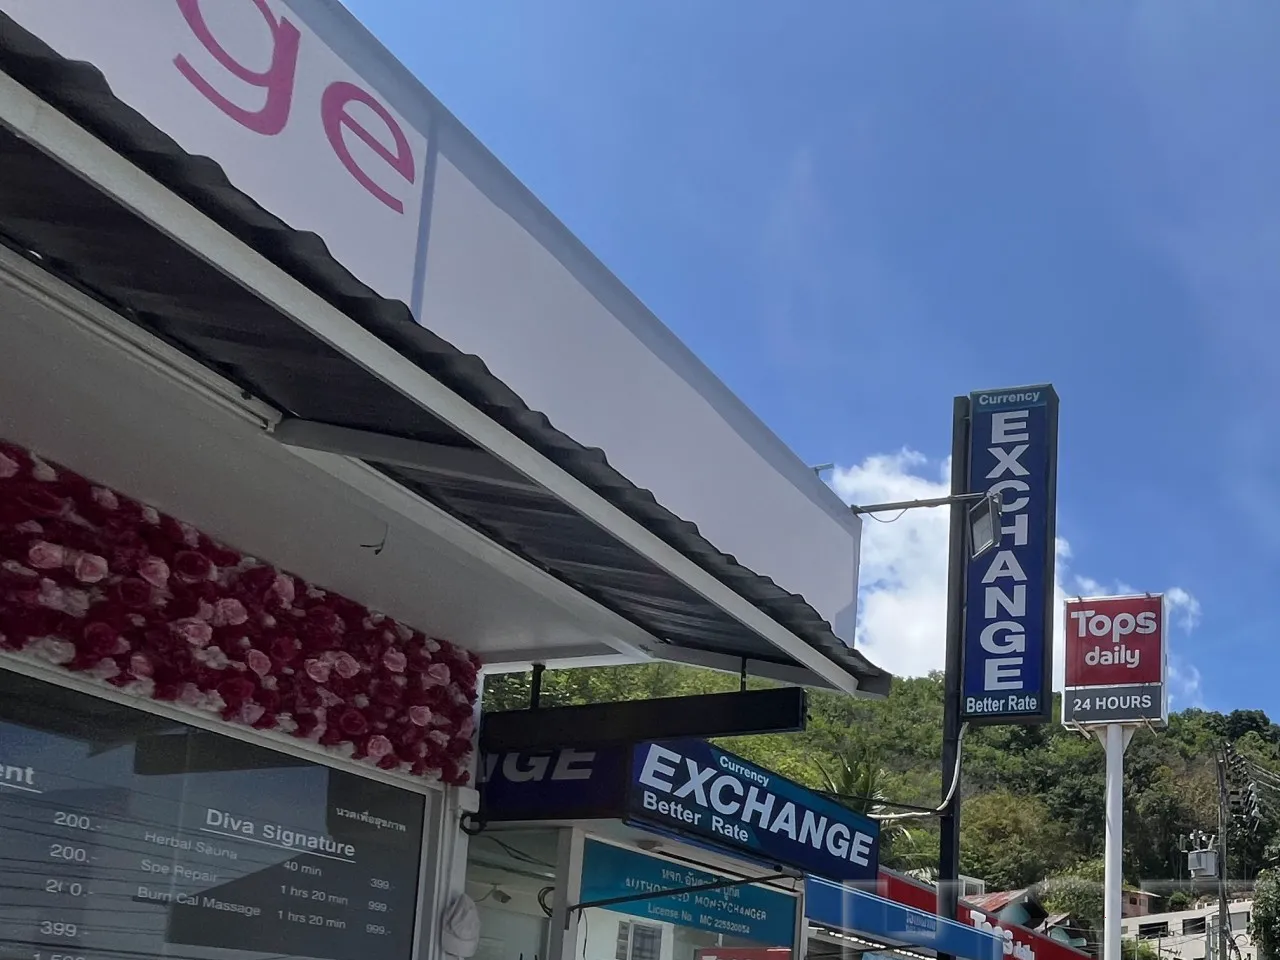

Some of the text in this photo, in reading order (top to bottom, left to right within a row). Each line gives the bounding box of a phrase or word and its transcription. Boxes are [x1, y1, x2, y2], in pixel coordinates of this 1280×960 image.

[979, 391, 1040, 406] Currency
[979, 410, 1030, 691] EXCHANGE
[1070, 610, 1157, 643] Tops
[1084, 645, 1140, 669] daily
[966, 696, 1038, 713] Better Rate
[1073, 694, 1152, 712] 24 HOURS
[719, 754, 770, 787] Currency
[638, 742, 875, 868] EXCHANGE
[643, 790, 749, 843] Better Rate
[144, 831, 192, 850] Herbal
[206, 808, 356, 858] Diva Signature
[283, 861, 322, 876] 40 min
[137, 886, 262, 917] Burn Cal Massage
[290, 886, 309, 899] hrs
[311, 890, 326, 901] 20
[328, 894, 348, 905] min
[287, 911, 306, 923] hrs
[308, 914, 323, 926] 20
[325, 919, 346, 929] min
